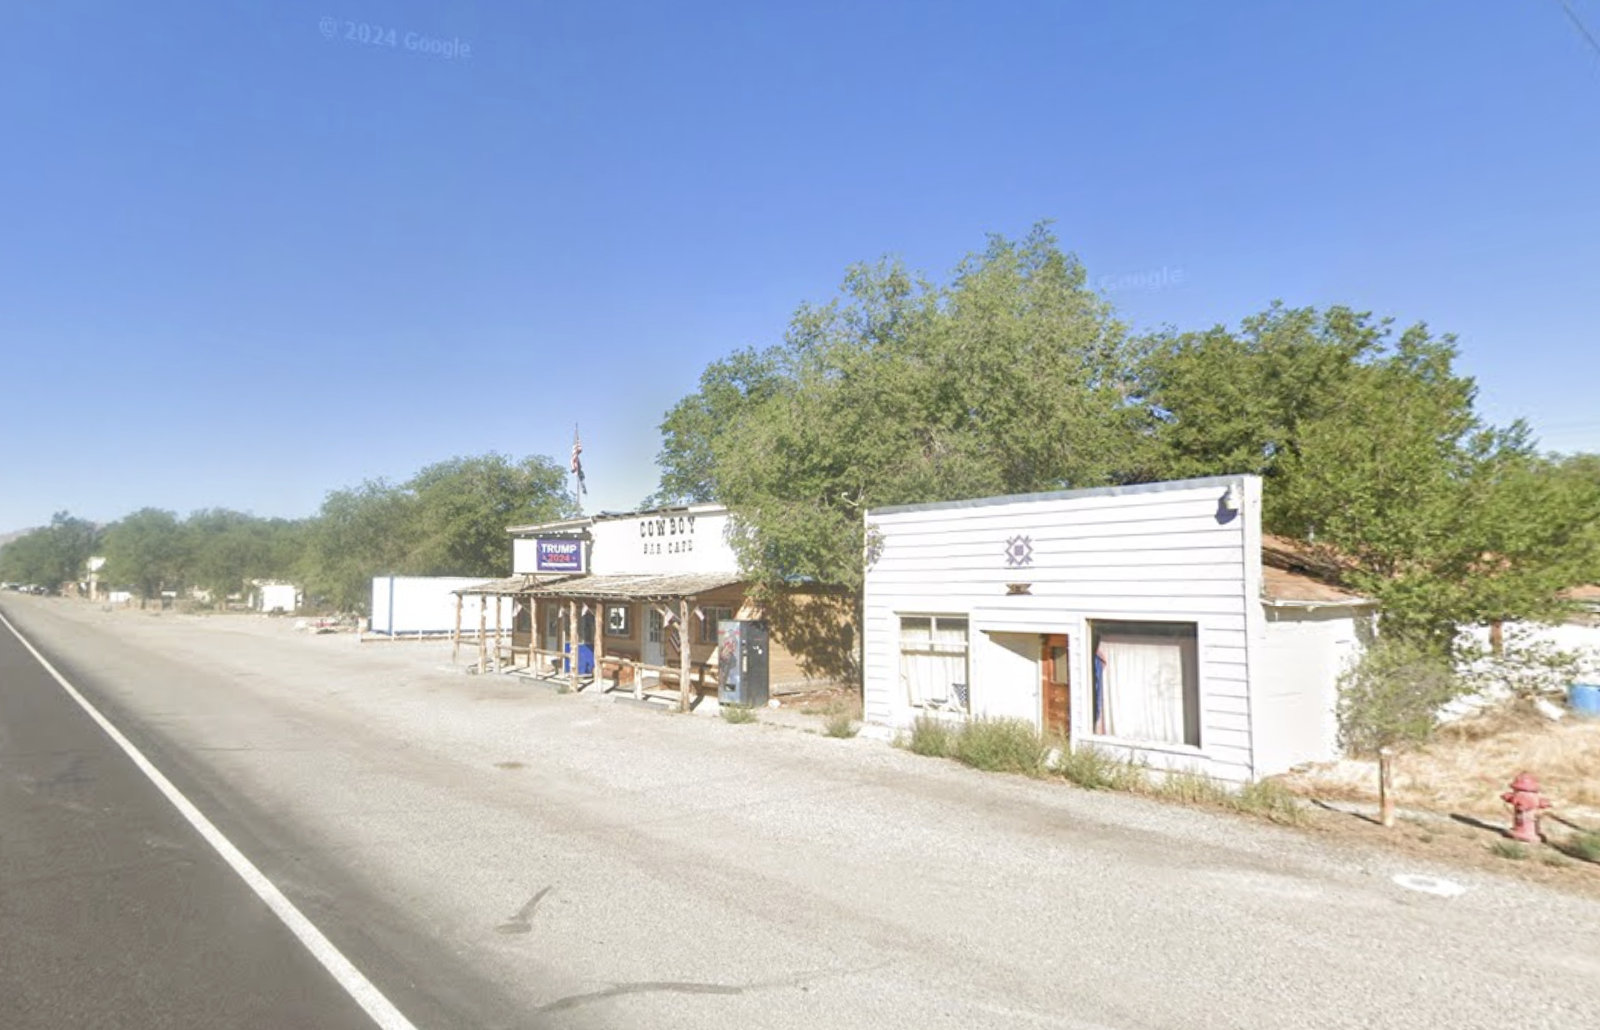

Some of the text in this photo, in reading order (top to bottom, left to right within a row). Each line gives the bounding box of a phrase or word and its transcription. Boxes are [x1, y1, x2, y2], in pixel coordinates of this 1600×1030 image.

[640, 516, 695, 538] COWBOY
[541, 543, 577, 554] TRUMP
[643, 539, 693, 555] BAR CAFE
[547, 554, 571, 563] 2024
